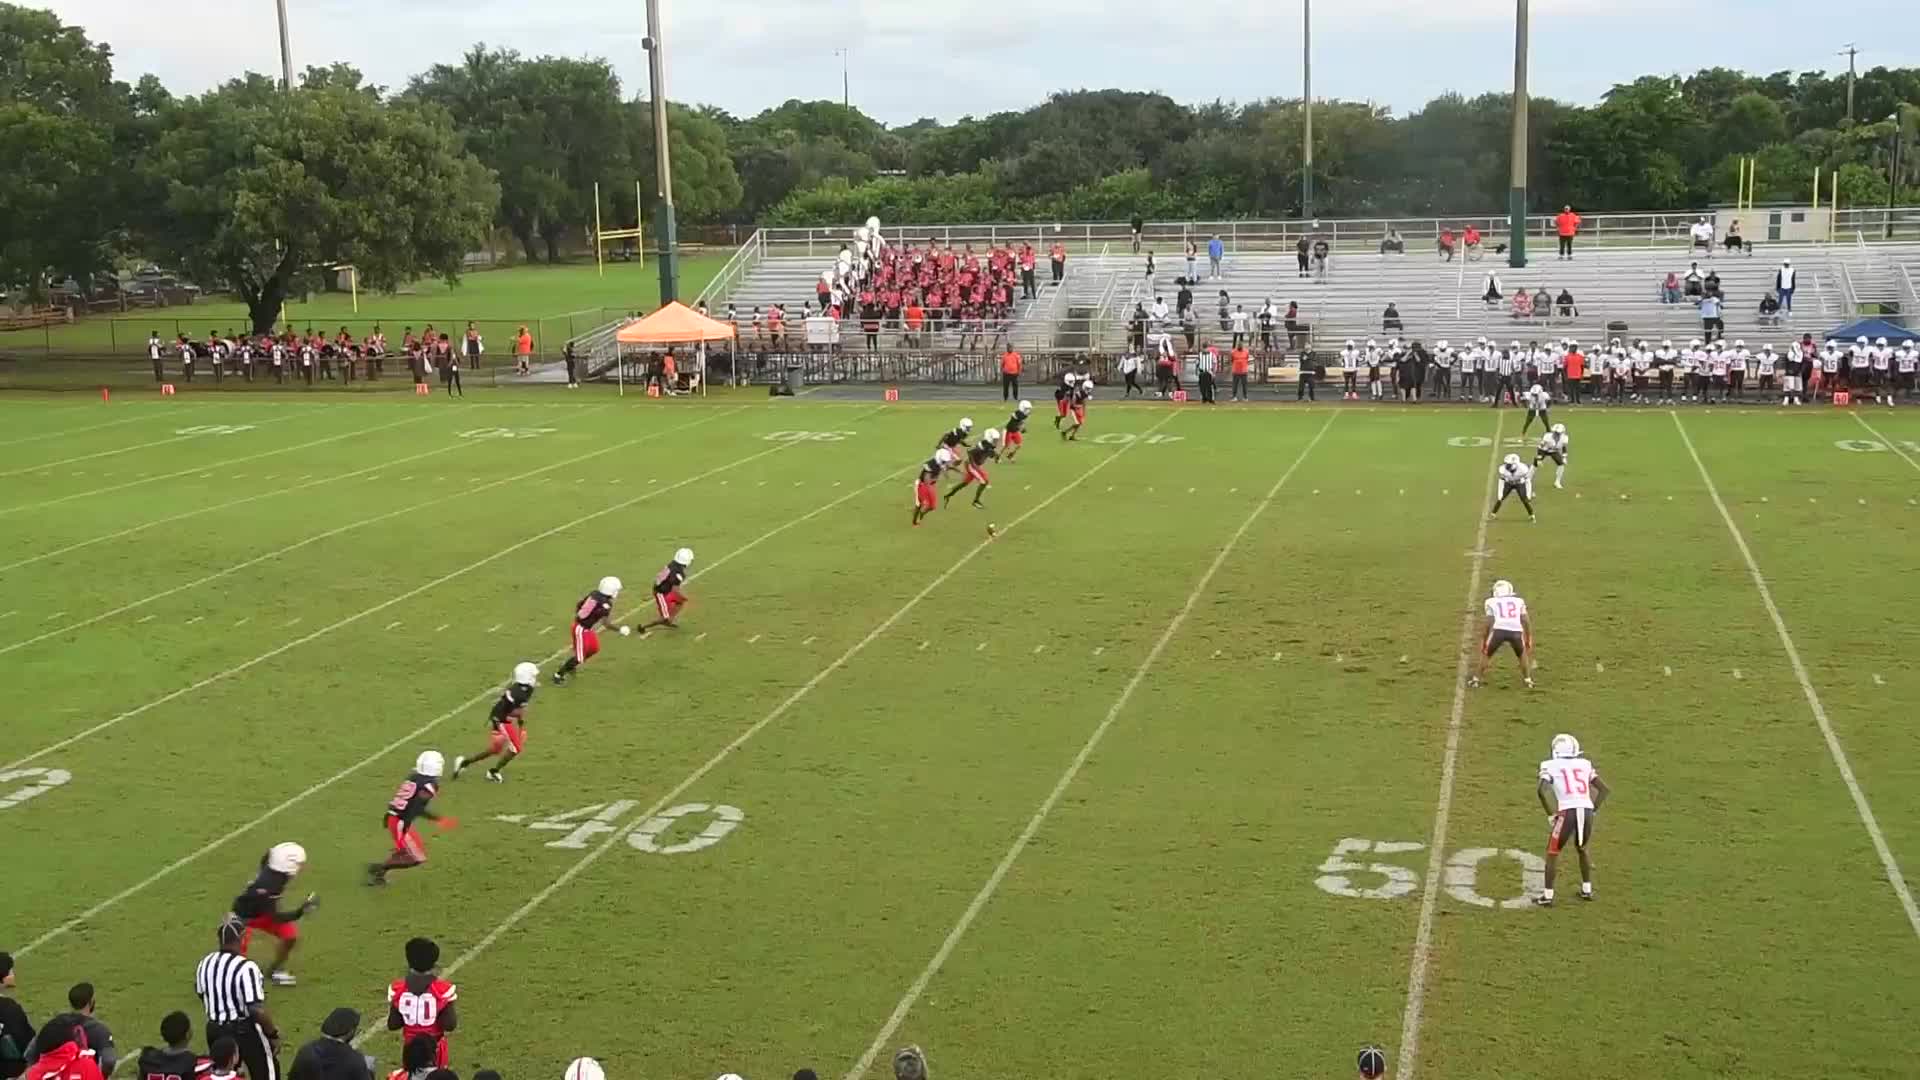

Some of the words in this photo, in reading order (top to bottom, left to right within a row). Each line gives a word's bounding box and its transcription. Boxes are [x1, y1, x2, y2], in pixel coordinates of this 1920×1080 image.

[1496, 601, 1517, 618] 12
[1560, 768, 1587, 794] 15
[528, 799, 745, 854] 40
[1313, 837, 1548, 909] 50
[398, 991, 437, 1027] 90
